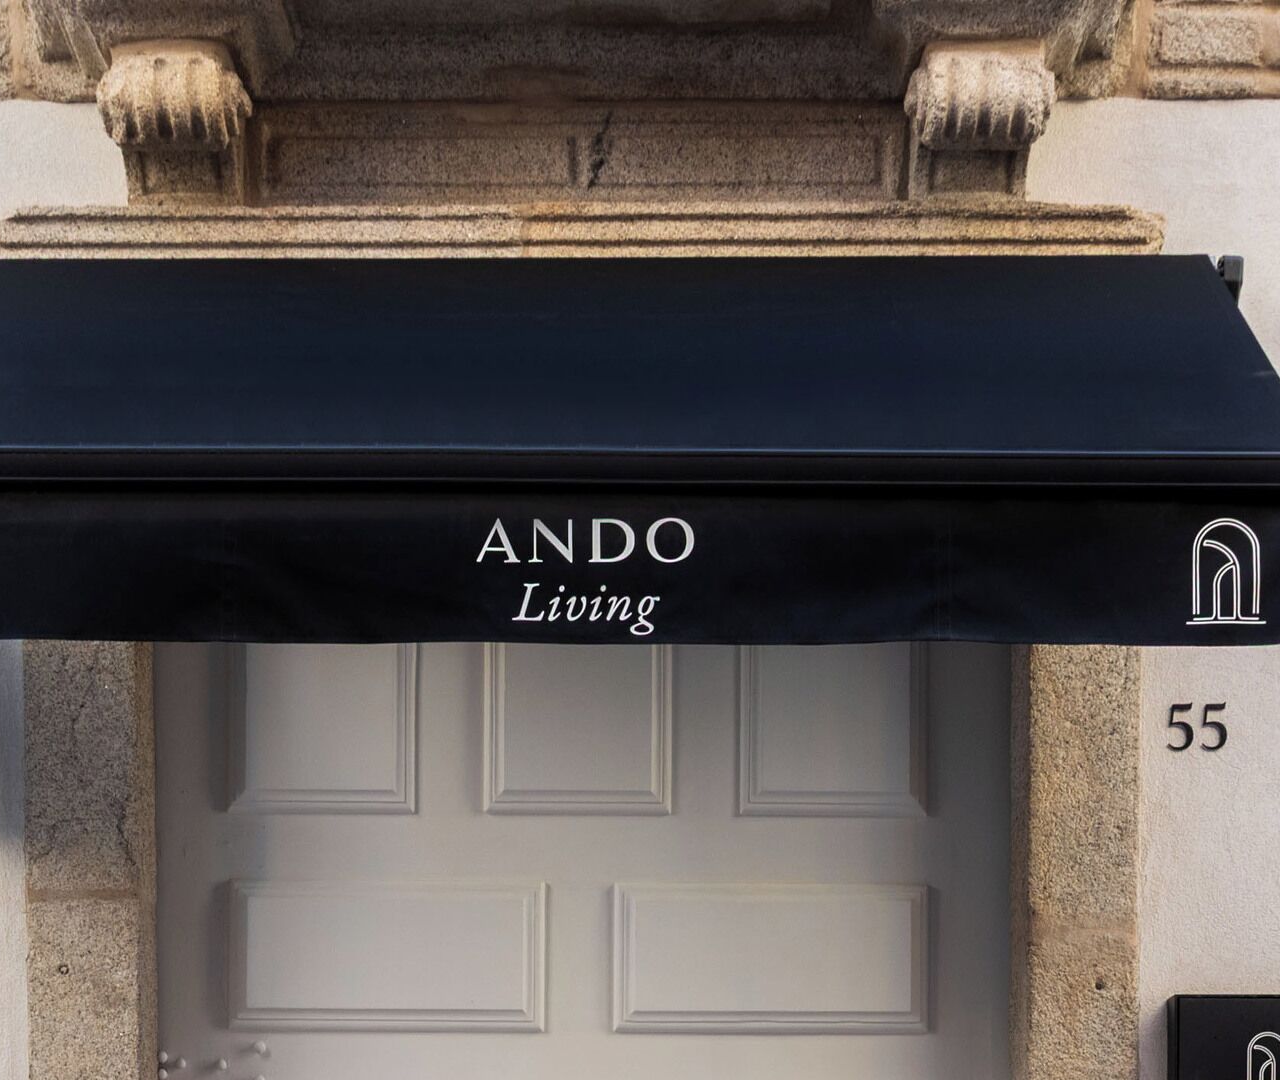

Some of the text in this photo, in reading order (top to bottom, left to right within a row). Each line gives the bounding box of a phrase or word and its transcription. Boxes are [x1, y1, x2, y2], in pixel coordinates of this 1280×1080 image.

[476, 517, 695, 563] ANDO
[512, 583, 661, 636] Living
[1167, 702, 1228, 752] 55
